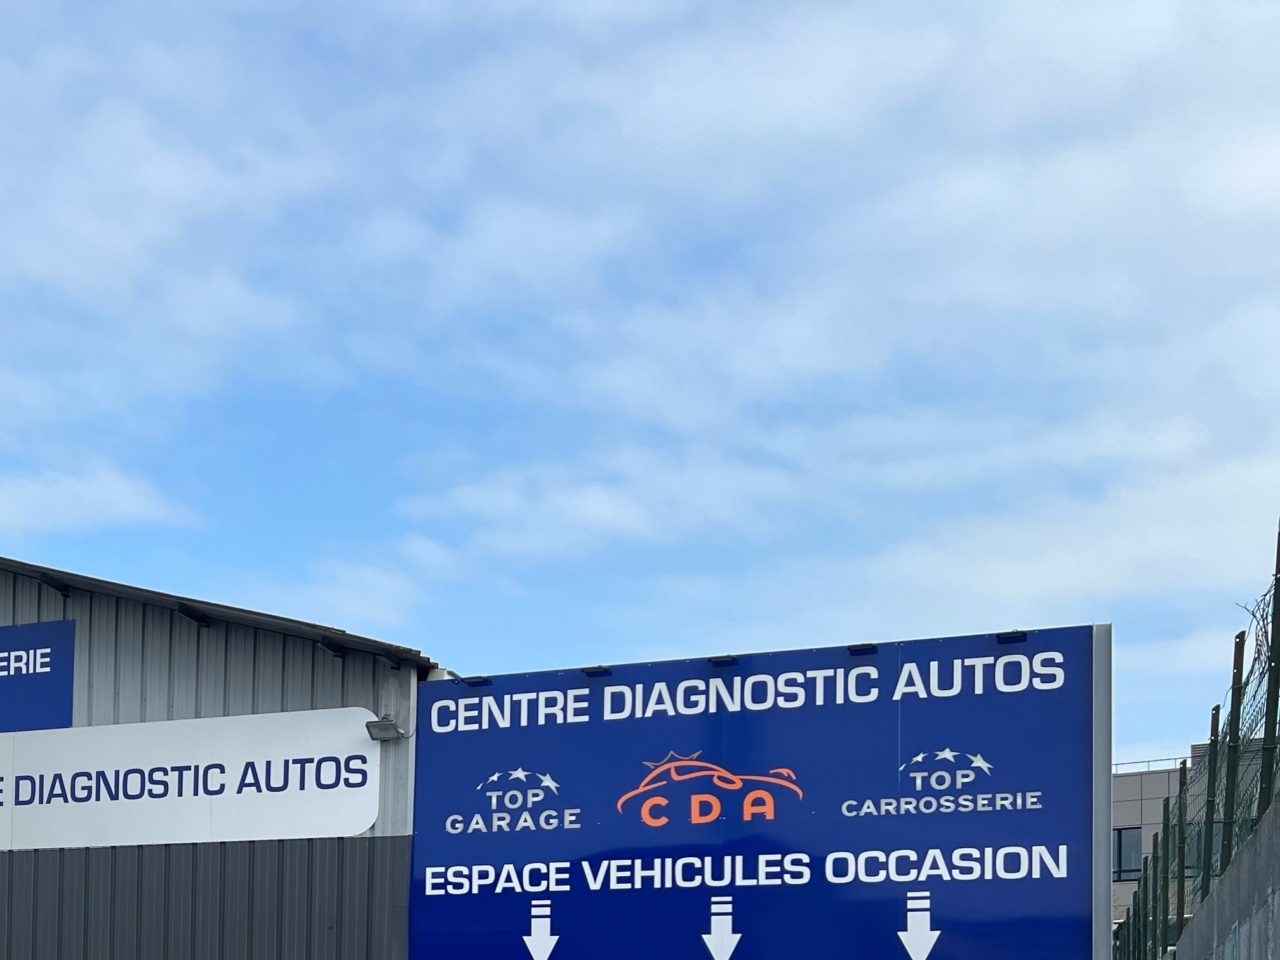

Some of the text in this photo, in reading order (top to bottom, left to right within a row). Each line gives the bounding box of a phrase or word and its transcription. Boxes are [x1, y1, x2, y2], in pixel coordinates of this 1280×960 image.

[431, 651, 1065, 734] CENTRE DIAGNOSTIC AUTOS
[14, 764, 225, 806] DIAGNOSTIC
[236, 754, 368, 794] AUTOS
[910, 769, 976, 791] TOP
[486, 788, 545, 810] TOP
[841, 791, 1043, 817] CARROSSERIE
[445, 808, 581, 835] GARAGE
[424, 844, 1069, 897] ESPACE VEHICULES OCCASION
